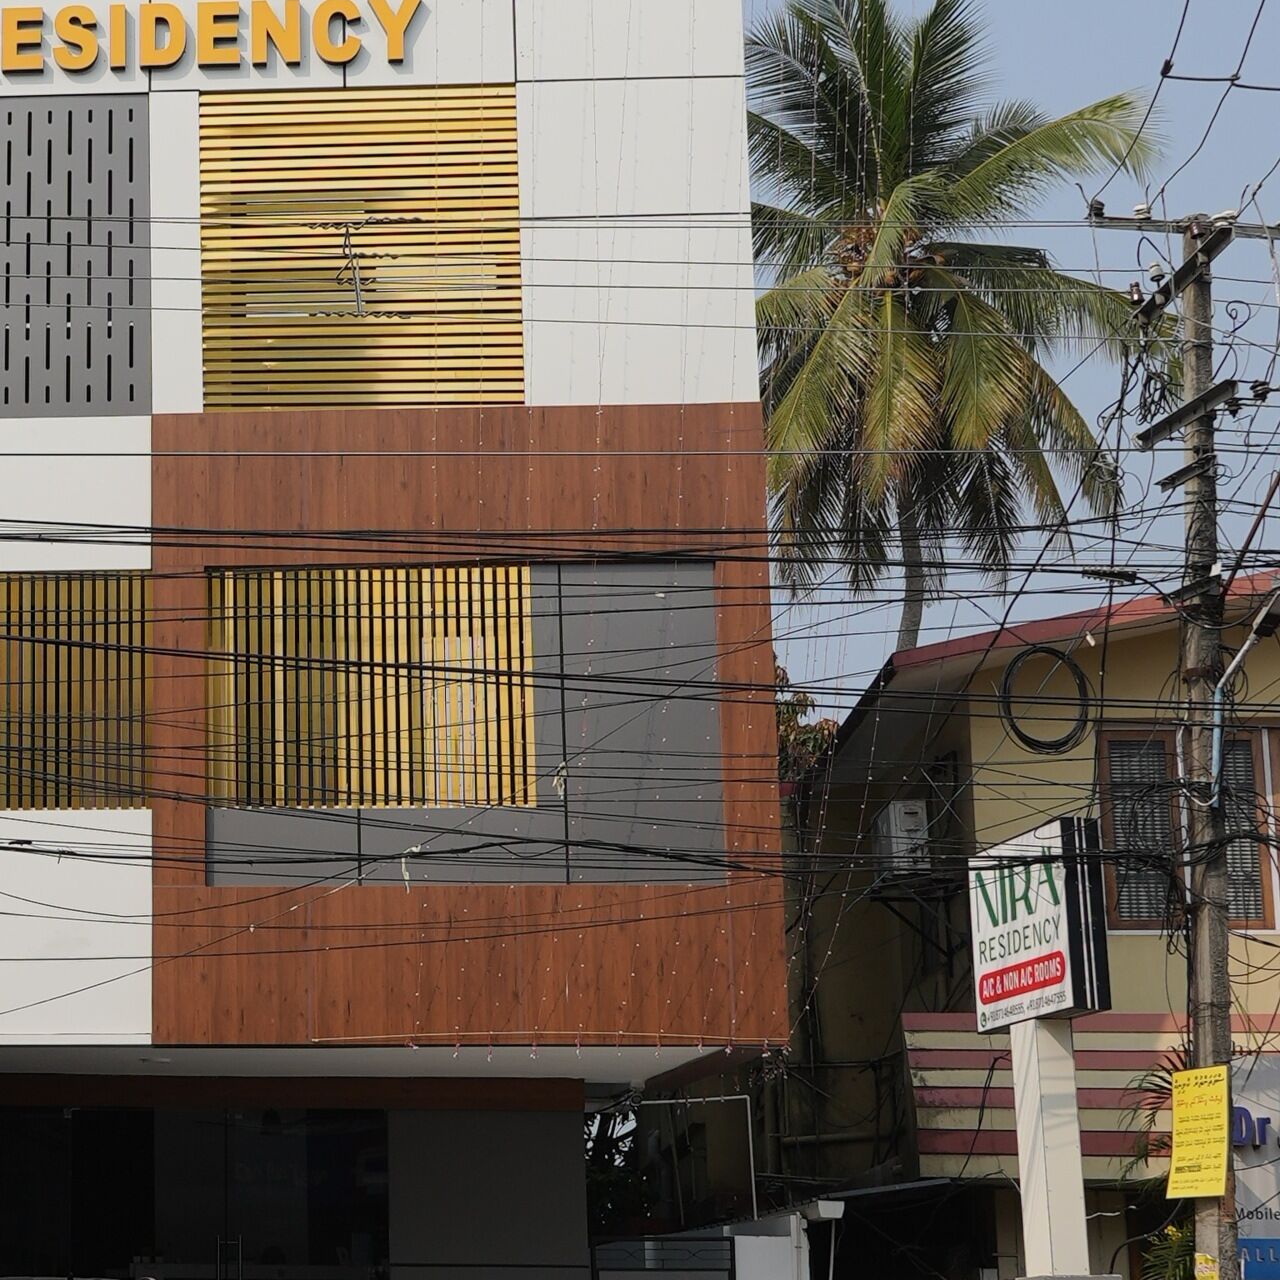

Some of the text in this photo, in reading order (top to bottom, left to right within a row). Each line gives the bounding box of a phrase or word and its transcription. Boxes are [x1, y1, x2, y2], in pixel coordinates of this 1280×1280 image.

[975, 846, 1061, 933] NIRA
[979, 913, 1061, 965] RESIDENCY
[982, 956, 1062, 999] A/C & NON A/C ROOMS
[1236, 1208, 1280, 1221] Mobile
